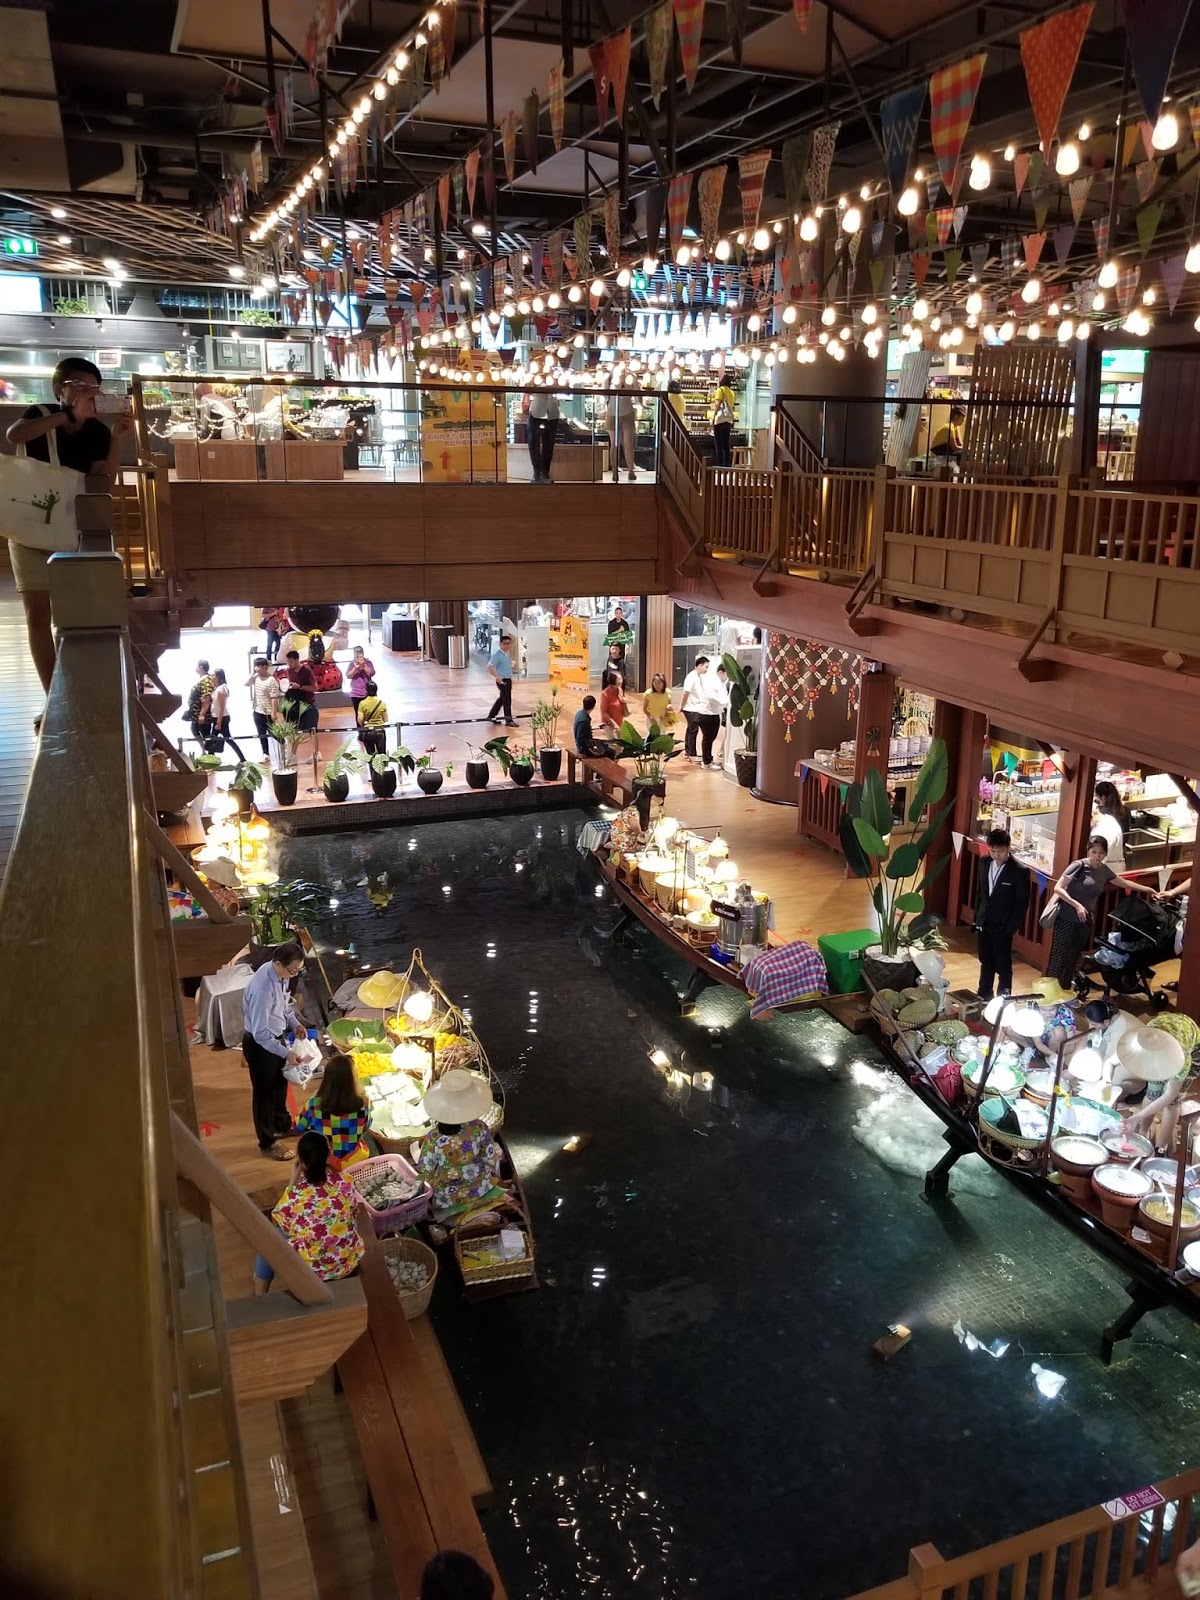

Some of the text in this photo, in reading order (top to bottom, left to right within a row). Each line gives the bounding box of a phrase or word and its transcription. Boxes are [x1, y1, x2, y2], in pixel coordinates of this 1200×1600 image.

[1125, 1489, 1152, 1503] DO NOT
[1128, 1494, 1160, 1509] SIT HERE
